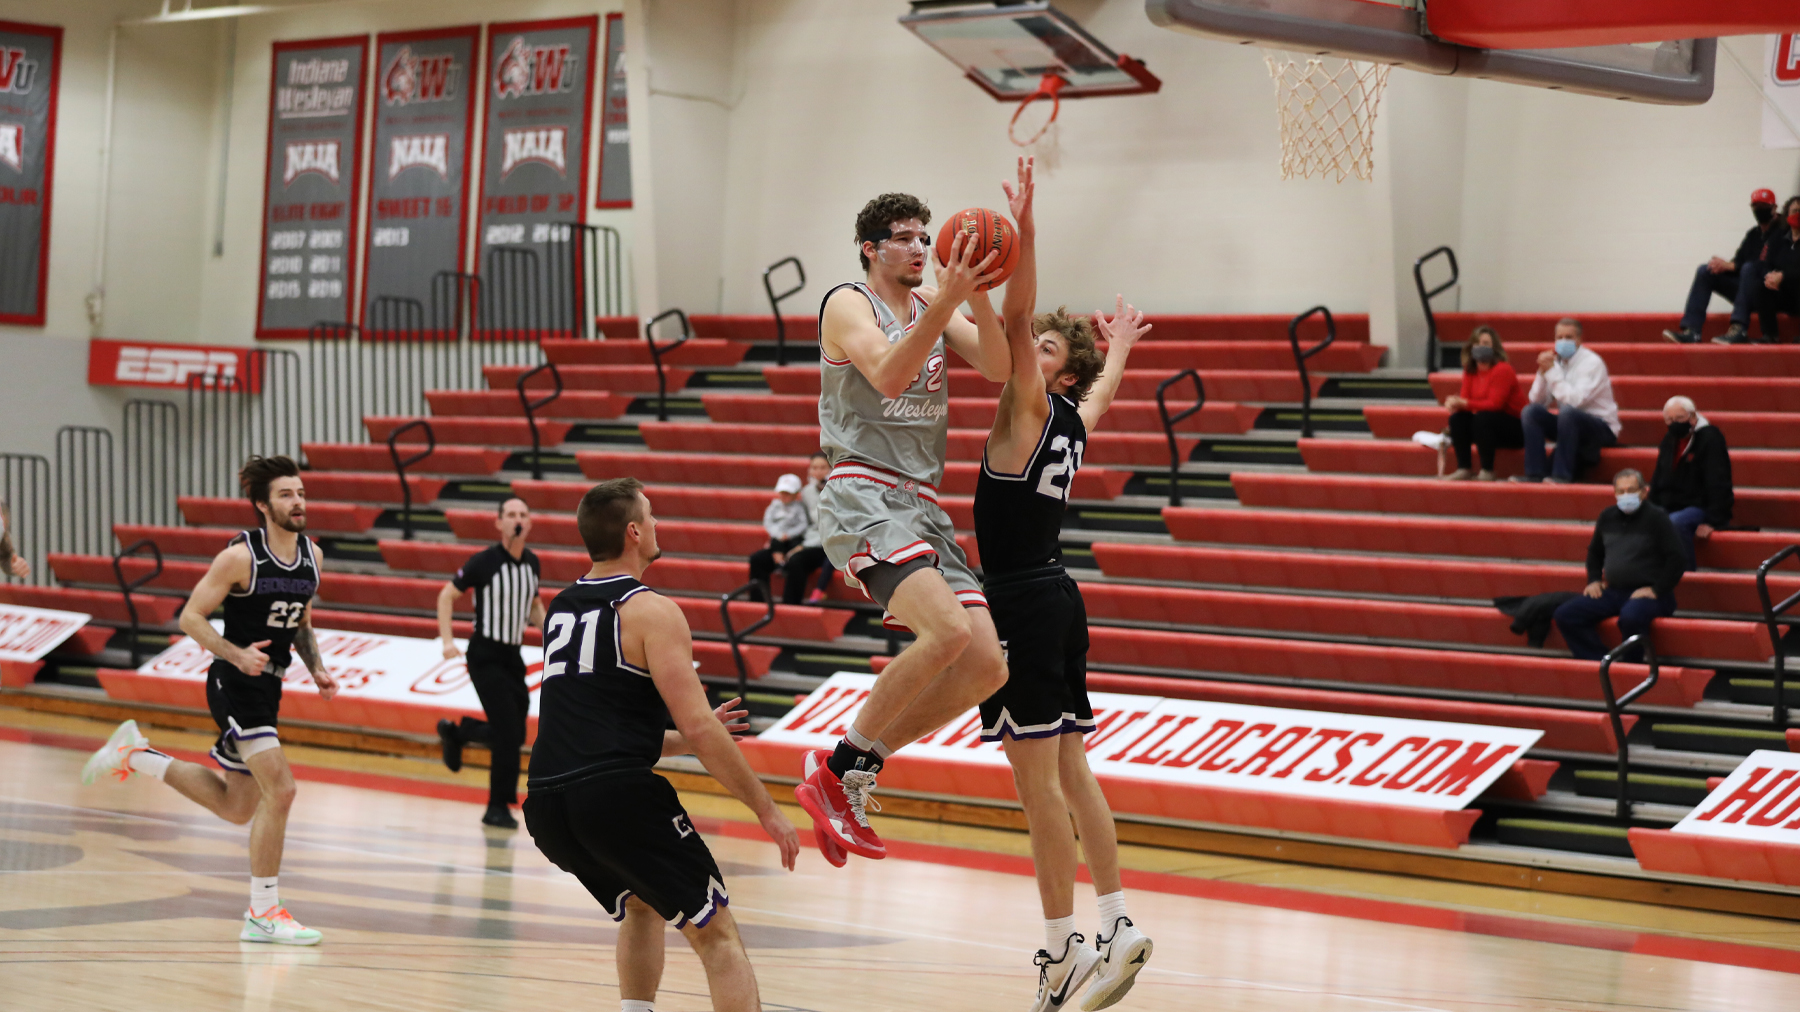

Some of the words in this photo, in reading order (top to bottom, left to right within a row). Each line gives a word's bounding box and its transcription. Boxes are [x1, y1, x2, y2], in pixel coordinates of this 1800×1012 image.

[287, 58, 349, 85] Indiana
[278, 85, 354, 116] Wesleyan
[285, 142, 340, 183] NAIA
[388, 134, 448, 178] NAIA
[502, 129, 565, 172] NAIA
[377, 197, 431, 220] SWEET
[115, 346, 238, 386] ESPN
[266, 601, 305, 629] 22
[542, 608, 603, 682] 21
